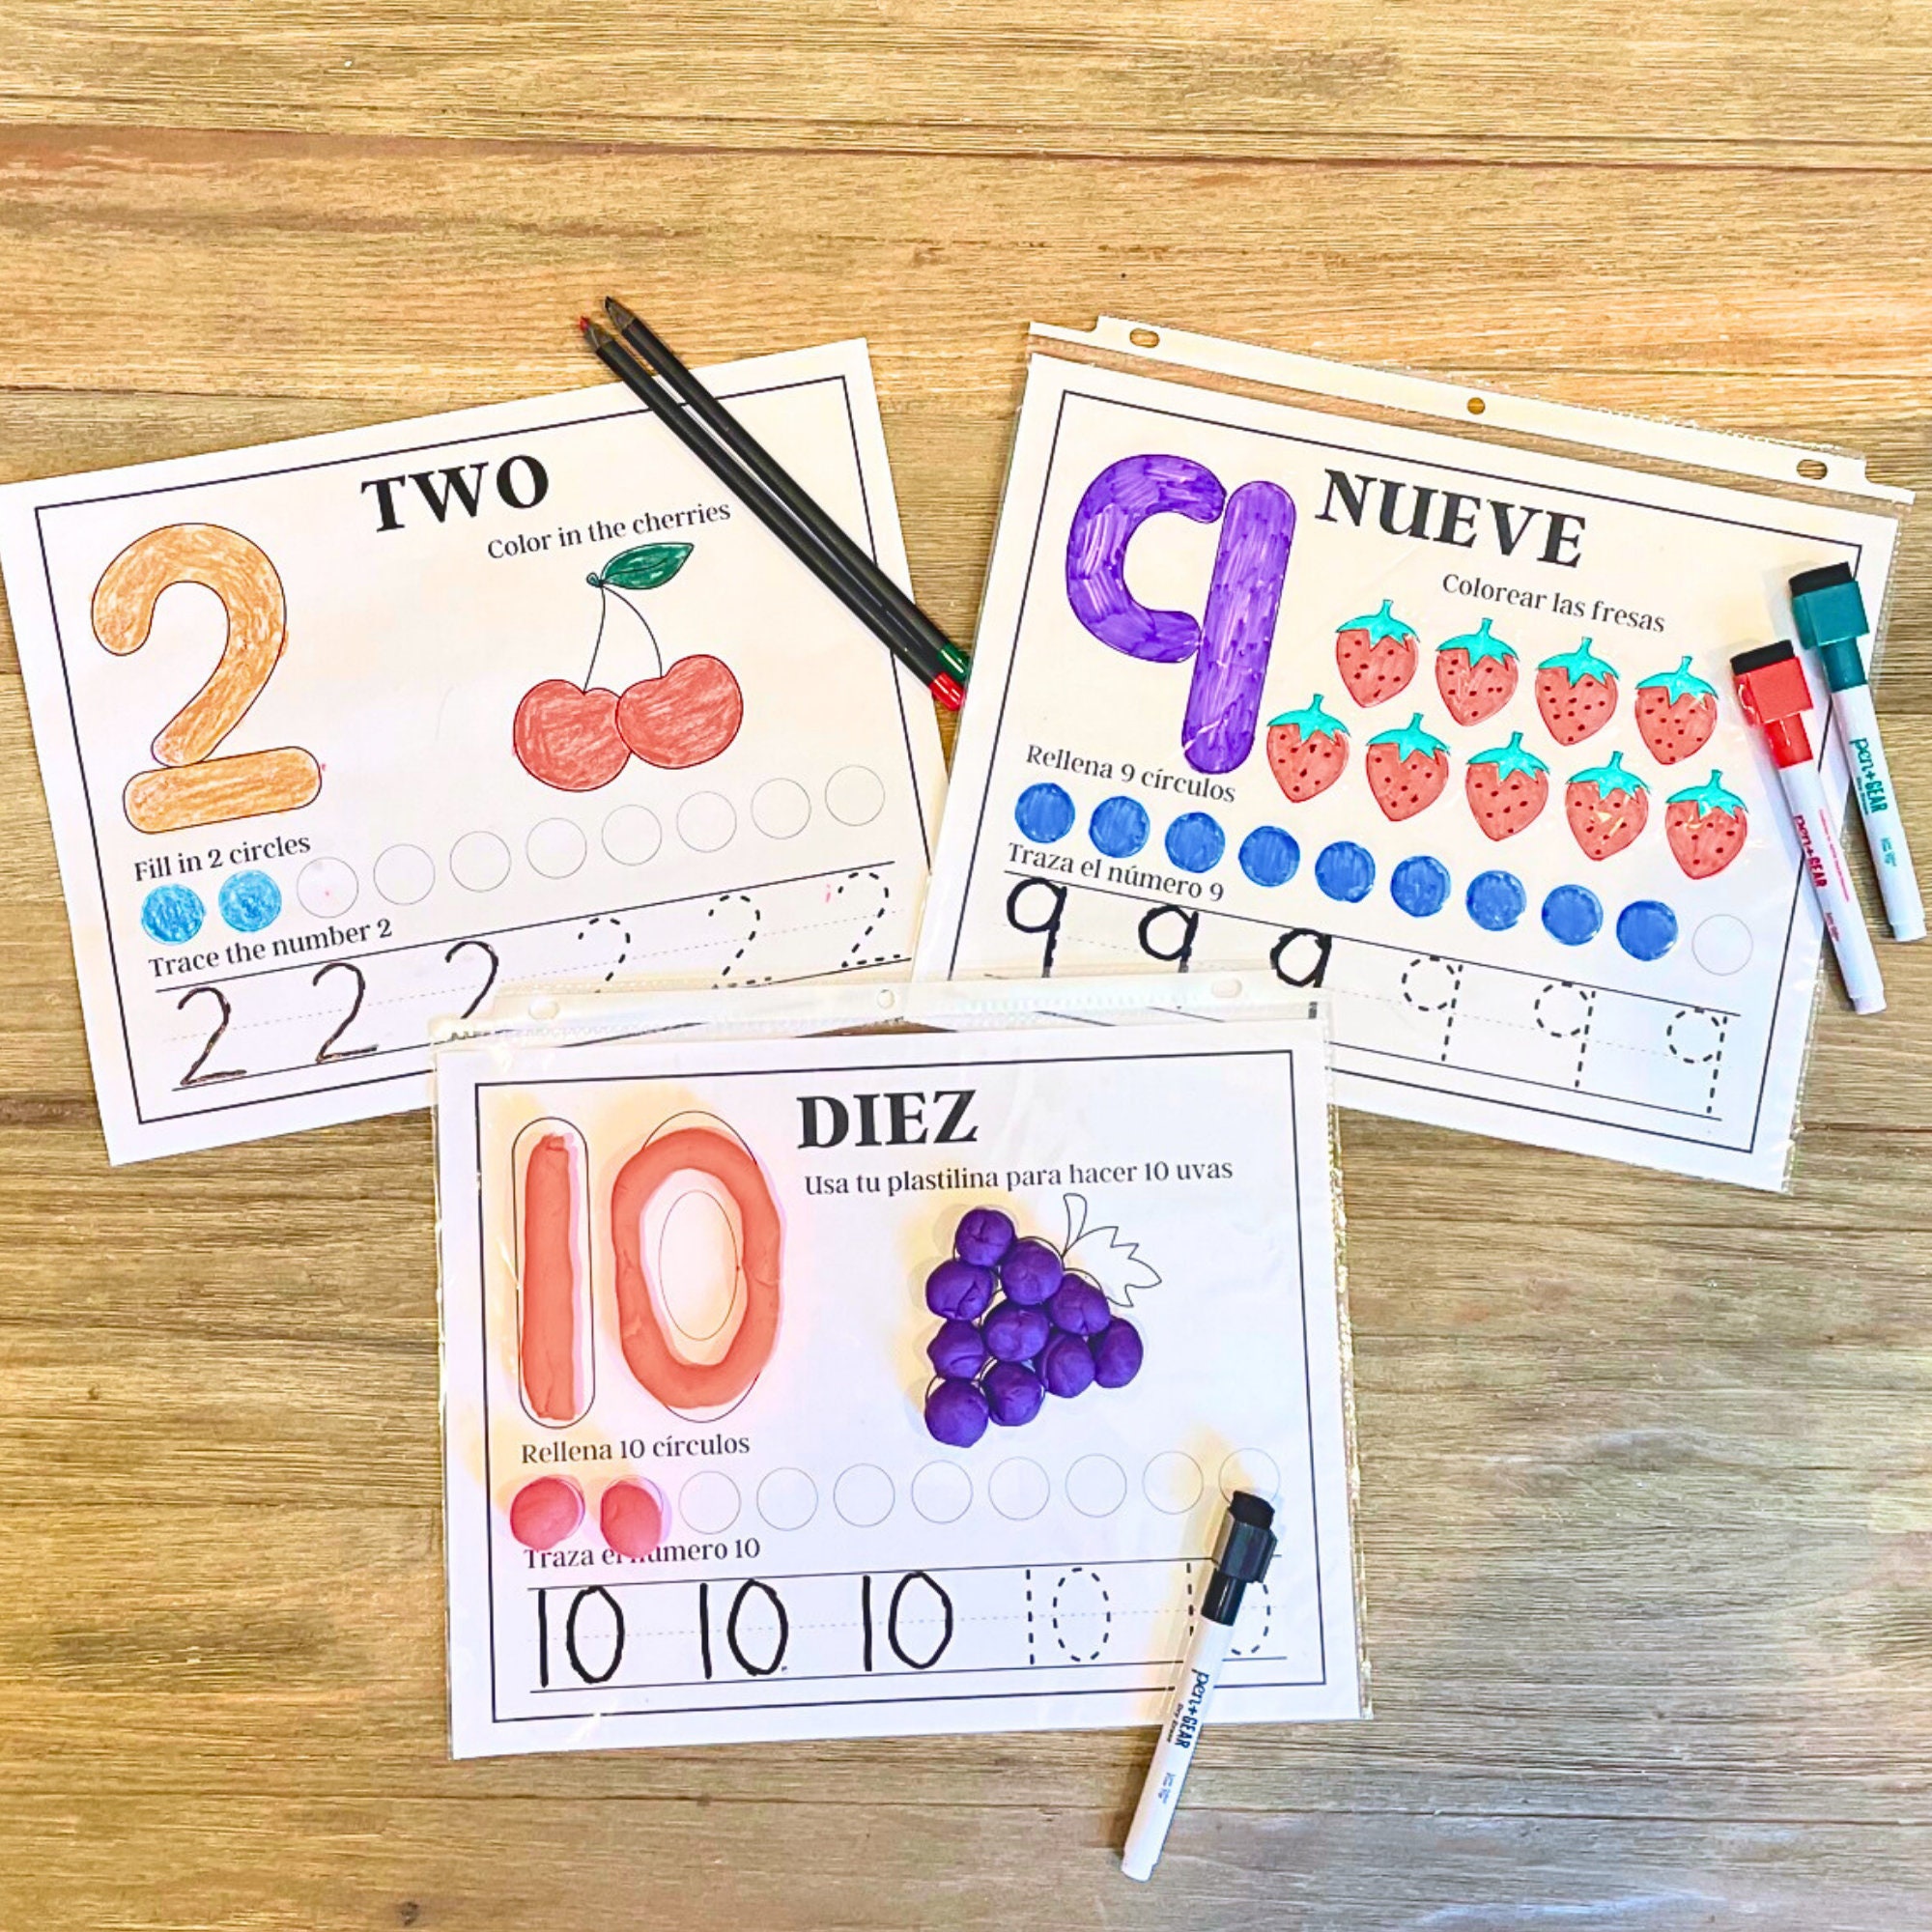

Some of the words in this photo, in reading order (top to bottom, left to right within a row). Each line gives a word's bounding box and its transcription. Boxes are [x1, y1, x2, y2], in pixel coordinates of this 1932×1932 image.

[361, 455, 549, 532] TWO
[1315, 468, 1586, 568] NUEVE
[488, 531, 552, 559] Color
[559, 527, 582, 547] in
[588, 520, 628, 542] the
[633, 503, 731, 534] cherries
[1066, 454, 1296, 775] 9
[1442, 574, 1546, 610] Colorear
[1553, 592, 1585, 617] las
[1592, 600, 1665, 633] fresas
[91, 522, 322, 834] 2
[1026, 745, 1113, 779] Rellena
[1121, 764, 1135, 781] 9
[1141, 768, 1236, 803] círculos
[134, 857, 172, 881] Fill
[178, 852, 202, 873] in
[207, 849, 223, 867] 2
[229, 837, 311, 865] circles
[1009, 842, 1073, 873] Traza
[1081, 859, 1102, 878] el
[1108, 865, 1203, 898] número
[1209, 883, 1224, 901] 9
[148, 947, 219, 978] Trace
[226, 938, 266, 963] the
[272, 922, 369, 956] number
[377, 919, 392, 937] 2
[177, 985, 246, 1086] 2
[312, 963, 380, 1065] 2
[838, 872, 901, 968] 2
[1007, 877, 1067, 978] 9
[1402, 954, 1463, 1062] 9
[1534, 980, 1596, 1088] 9
[1666, 1007, 1727, 1114] 9
[796, 1090, 979, 1150] DIEZ
[805, 1175, 848, 1195] Usa
[857, 1173, 881, 1193] tu
[887, 1166, 999, 1197] plastilina
[1007, 1168, 1062, 1191] para
[1069, 1163, 1137, 1184] hacer
[1145, 1161, 1168, 1181] 10
[1177, 1161, 1233, 1181] uvas
[512, 1111, 781, 1430] 10
[522, 1439, 612, 1463] Rellena
[620, 1438, 644, 1460] 10
[653, 1434, 751, 1459] círculos
[525, 1547, 595, 1569] Traza
[735, 1537, 760, 1558] 10
[538, 1584, 625, 1688] 10
[698, 1578, 789, 1679] 10
[863, 1570, 953, 1672] 10
[1026, 1567, 1111, 1664] 10
[1174, 1668, 1210, 1749] pen+GEAR
